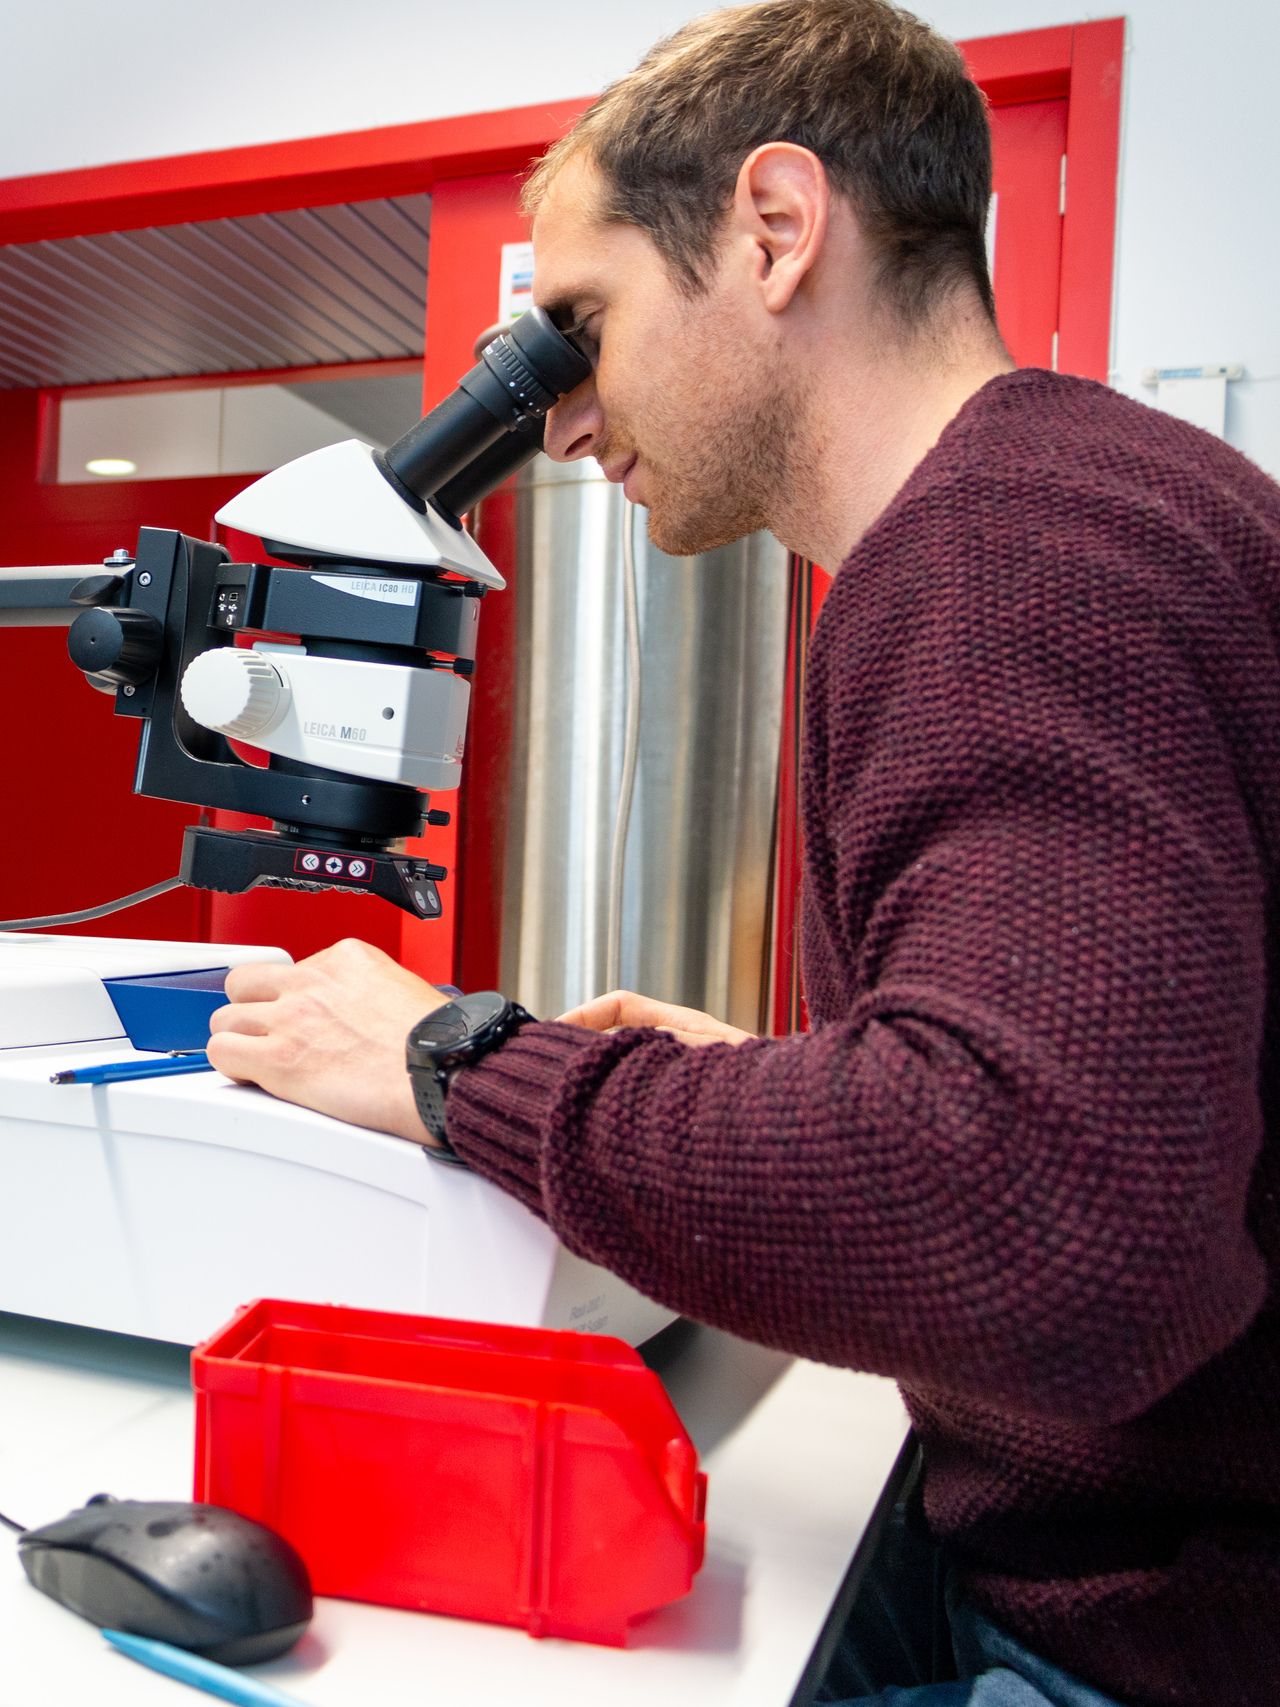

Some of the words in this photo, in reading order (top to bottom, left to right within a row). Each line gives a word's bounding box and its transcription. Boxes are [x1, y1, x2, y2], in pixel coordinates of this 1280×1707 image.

[351, 581, 376, 592] LEICA
[379, 583, 398, 593] IC80
[401, 584, 415, 594] HD
[303, 721, 336, 738] LEICA
[340, 726, 367, 741] M60
